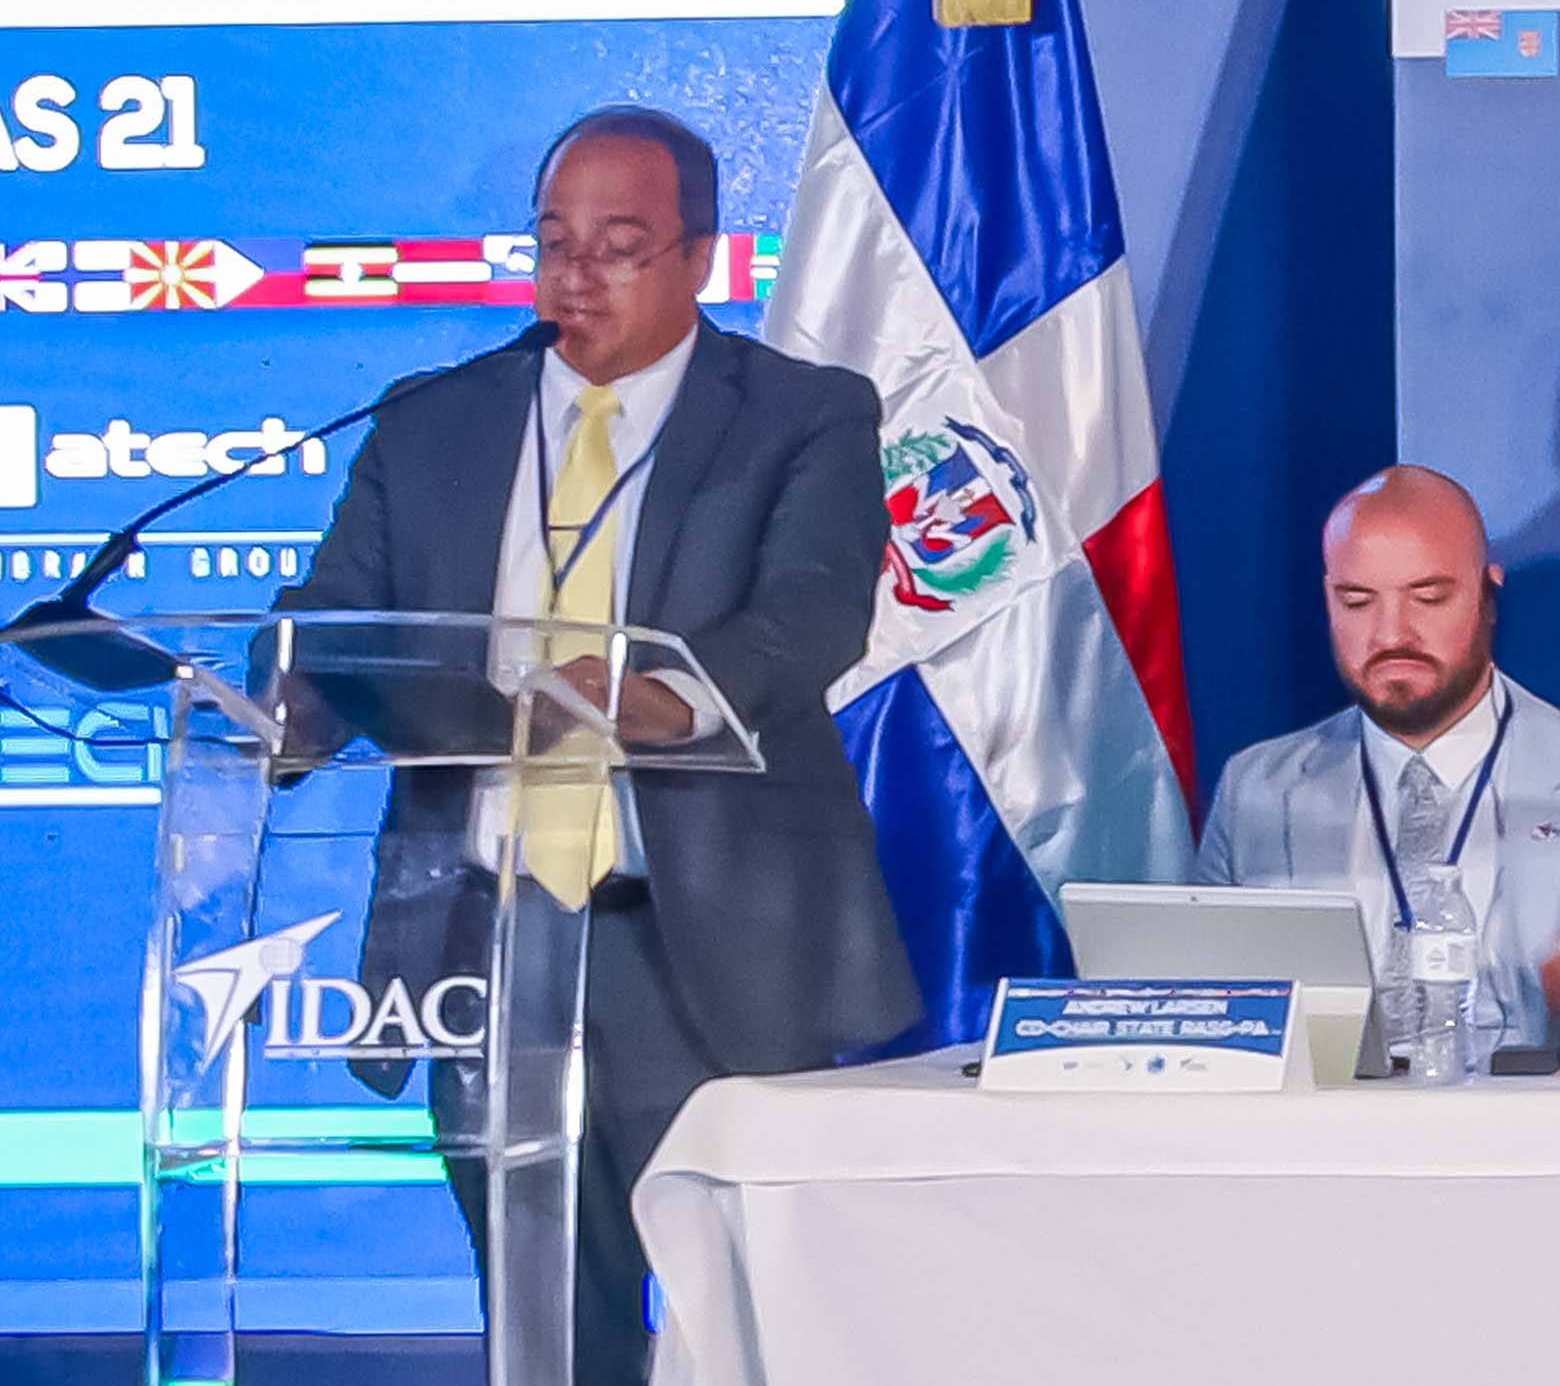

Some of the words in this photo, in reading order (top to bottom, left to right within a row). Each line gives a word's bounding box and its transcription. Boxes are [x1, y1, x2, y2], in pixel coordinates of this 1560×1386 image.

[100, 74, 206, 170] 21
[45, 417, 326, 478] atech
[266, 976, 489, 1047] IDAC
